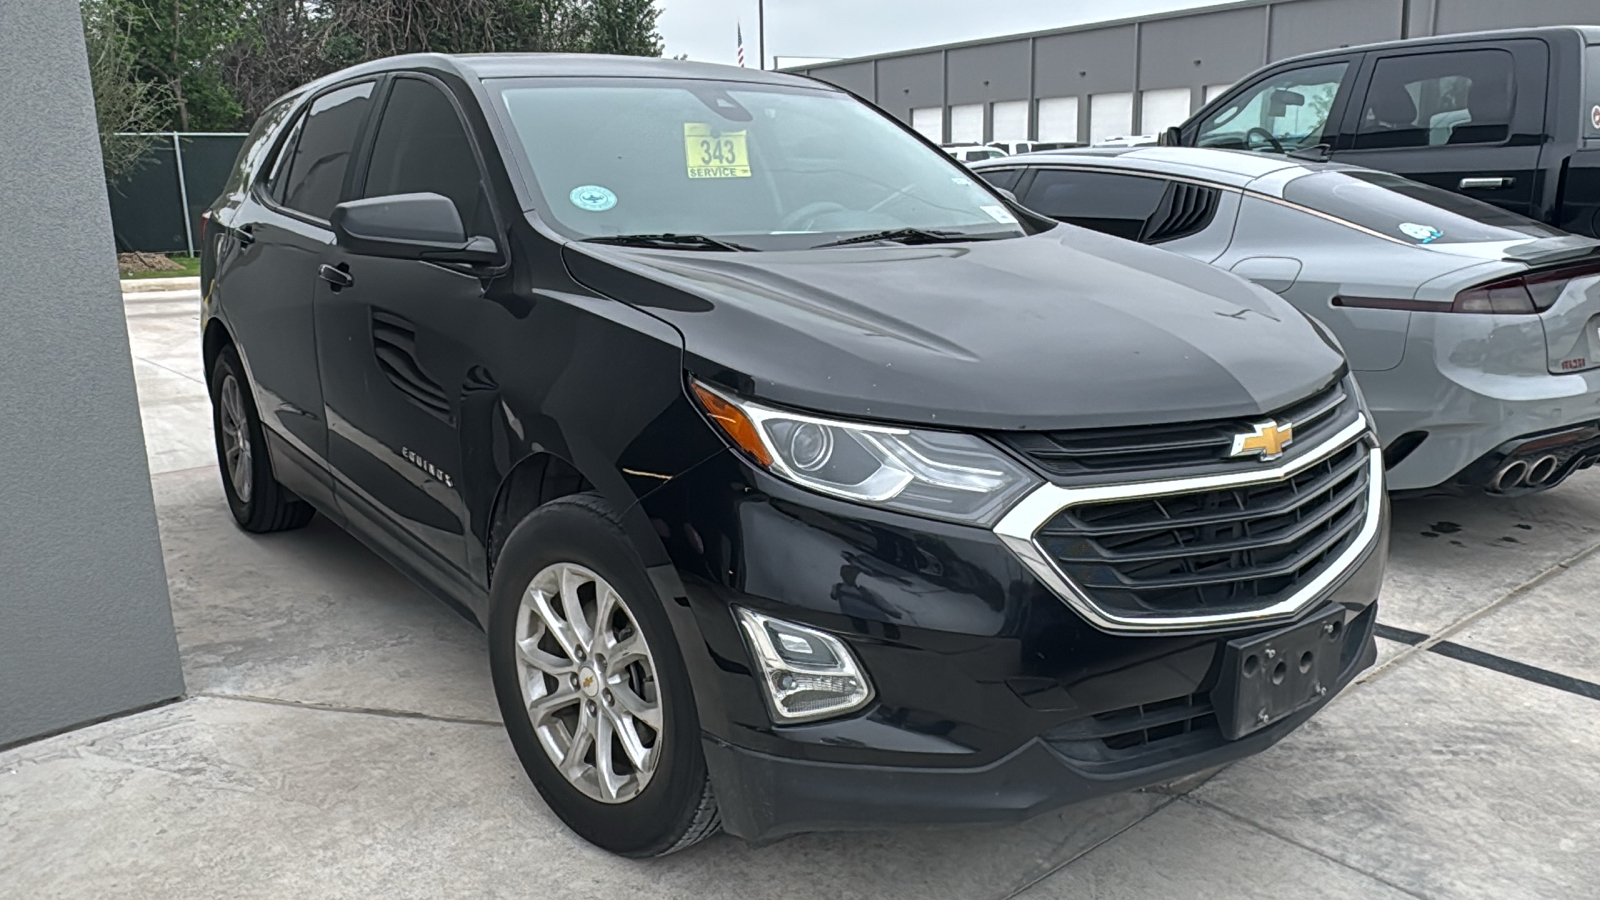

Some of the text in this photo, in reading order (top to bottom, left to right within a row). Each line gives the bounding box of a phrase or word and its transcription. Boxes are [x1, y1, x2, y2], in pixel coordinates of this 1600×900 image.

[700, 139, 736, 165] 343
[689, 167, 737, 177] SERVICE
[401, 446, 454, 488] EQUINOX
